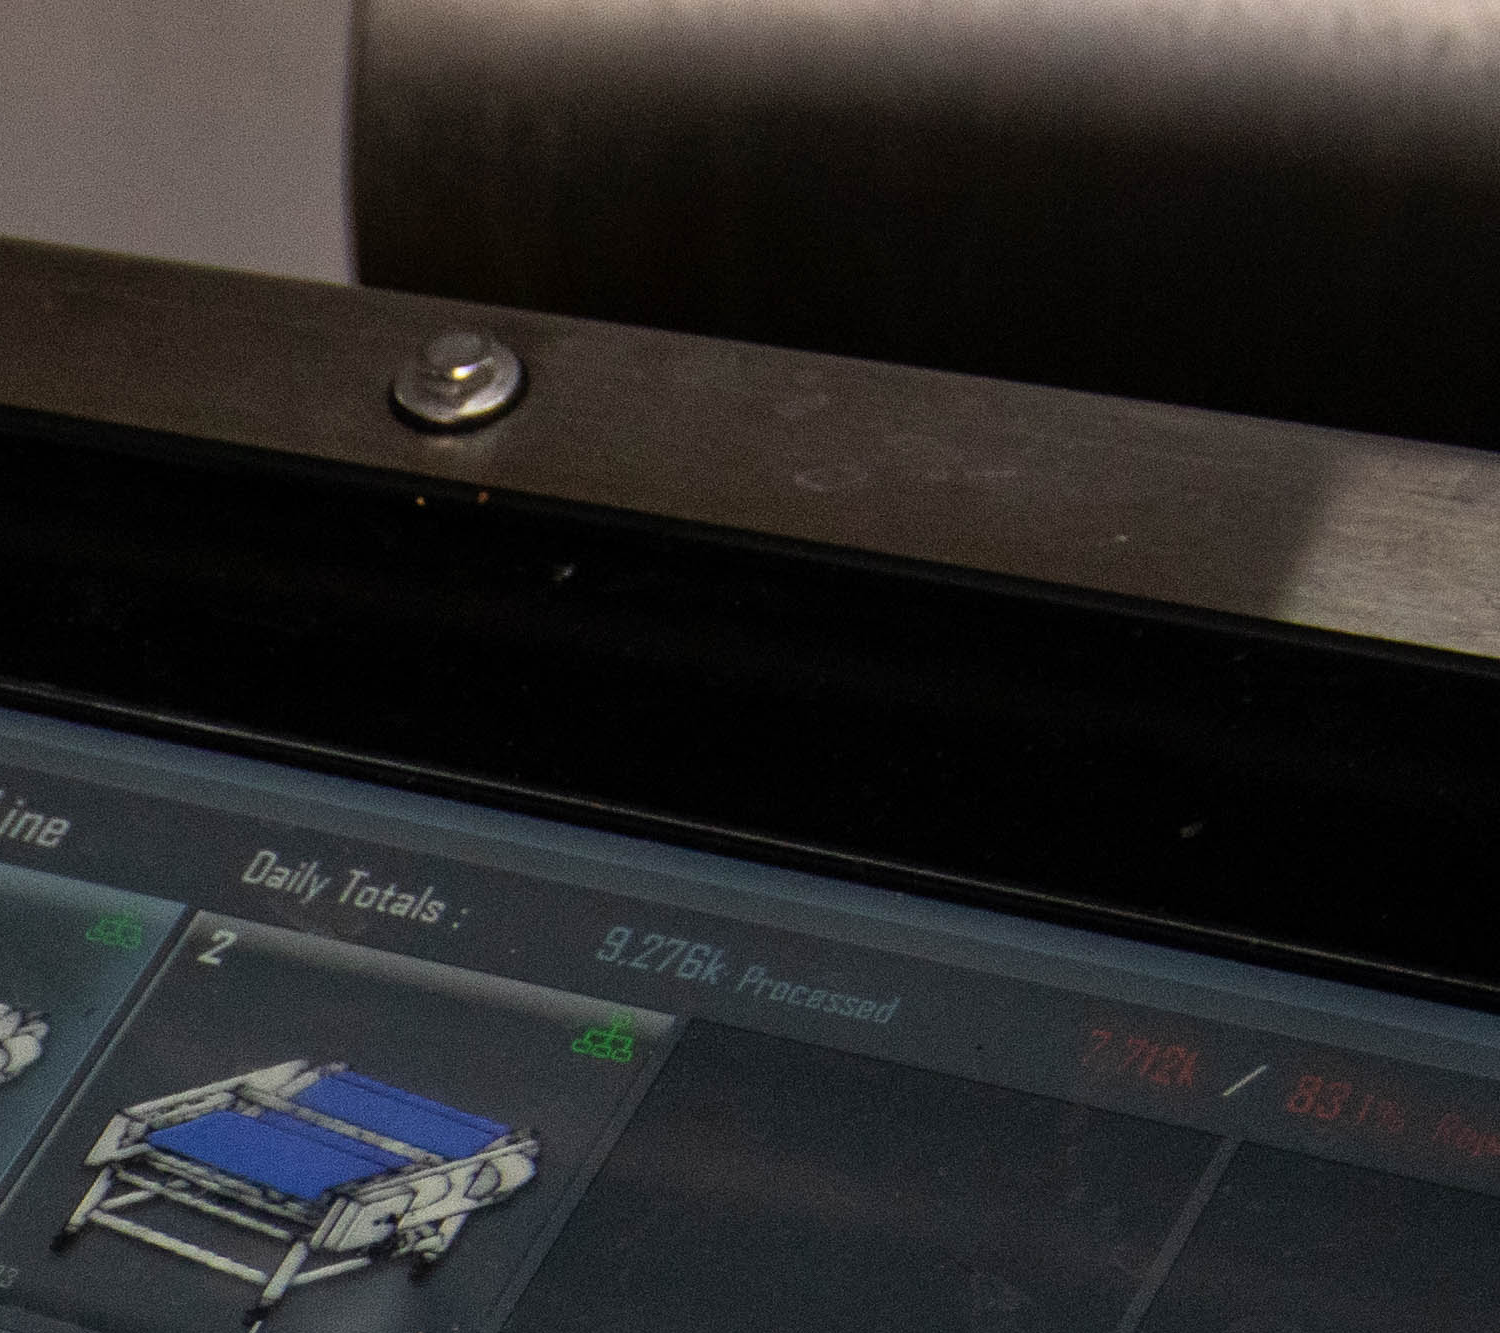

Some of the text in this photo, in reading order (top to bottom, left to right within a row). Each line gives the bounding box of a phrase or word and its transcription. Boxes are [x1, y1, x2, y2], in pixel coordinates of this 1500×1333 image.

[242, 850, 331, 900] Daily
[336, 870, 443, 924] Totals
[197, 932, 235, 965] 2
[594, 925, 902, 1026] 9.276k Processed
